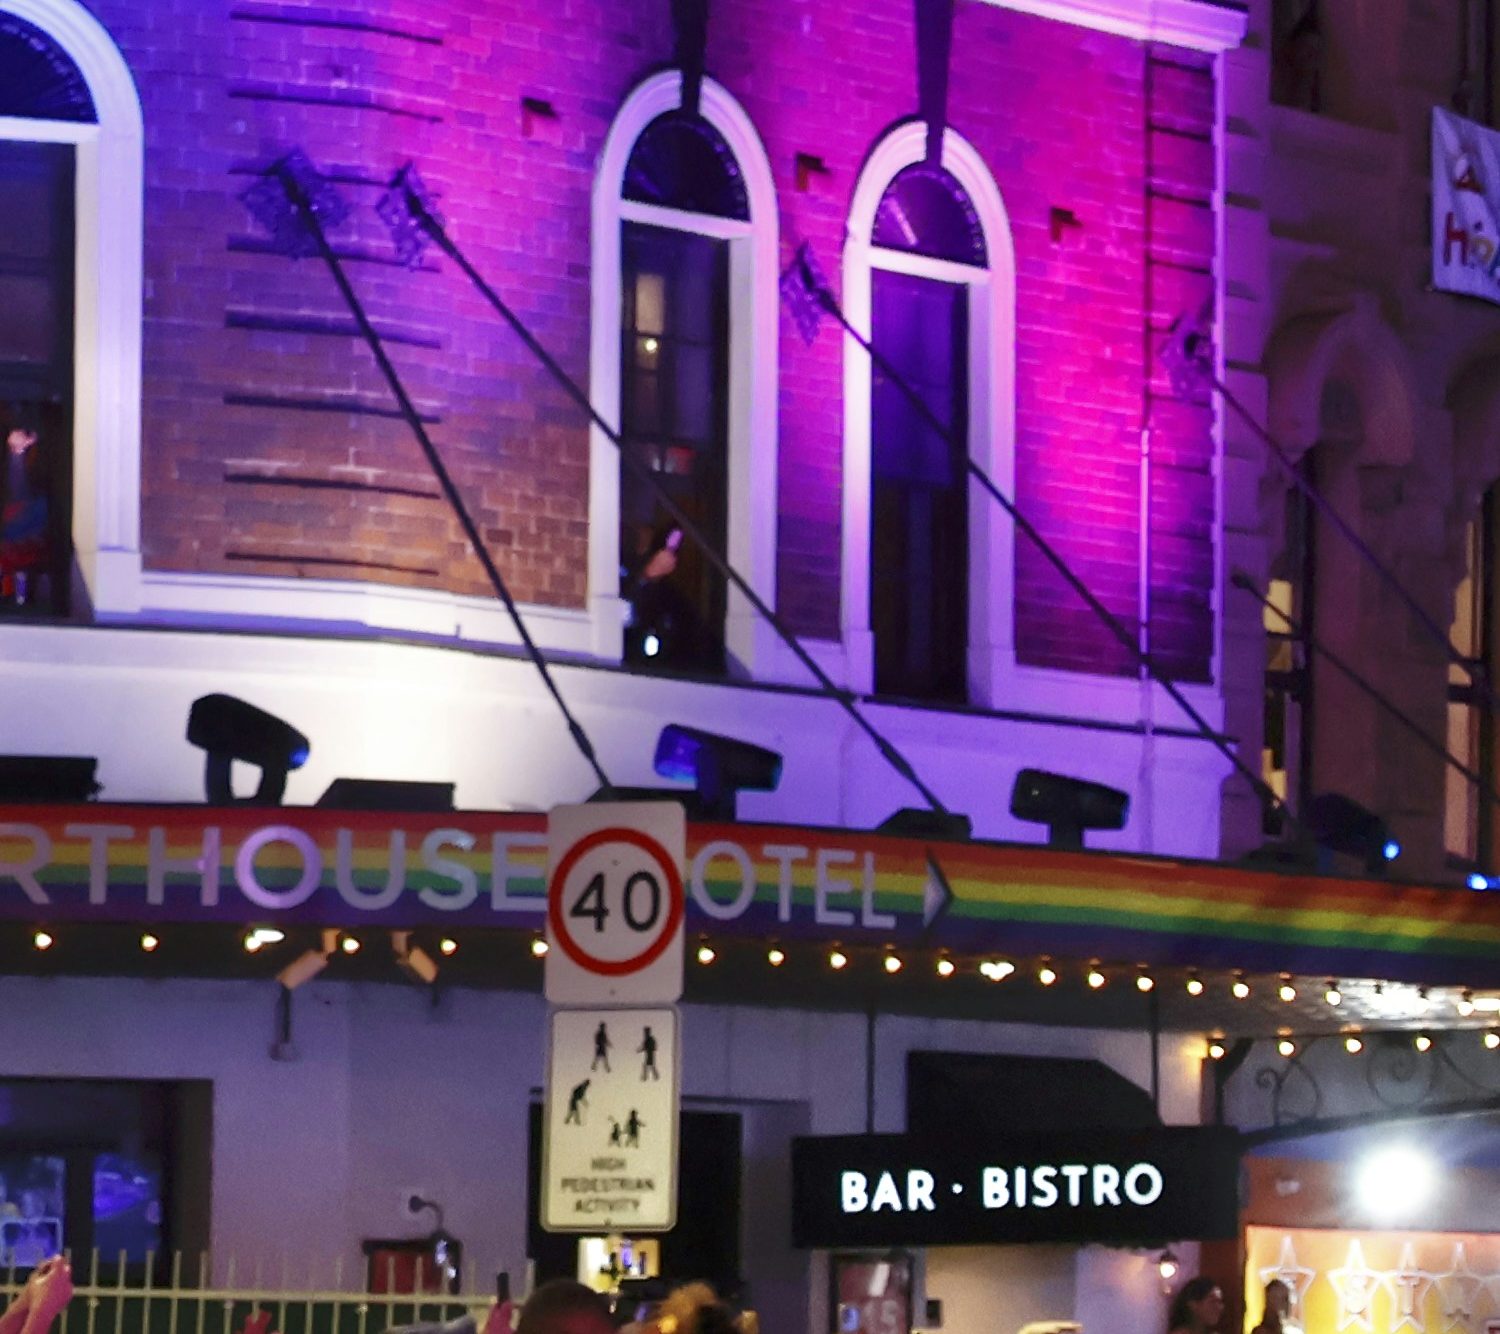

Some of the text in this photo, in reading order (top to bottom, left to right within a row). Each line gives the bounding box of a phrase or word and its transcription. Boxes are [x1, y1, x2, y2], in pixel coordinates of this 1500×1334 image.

[569, 871, 661, 935] 40
[691, 839, 897, 929] OTEL
[561, 1176, 655, 1193] PEDESTRIAN
[574, 1197, 641, 1214] ACTIVITY
[840, 1162, 1166, 1214] BAR BISTRO
